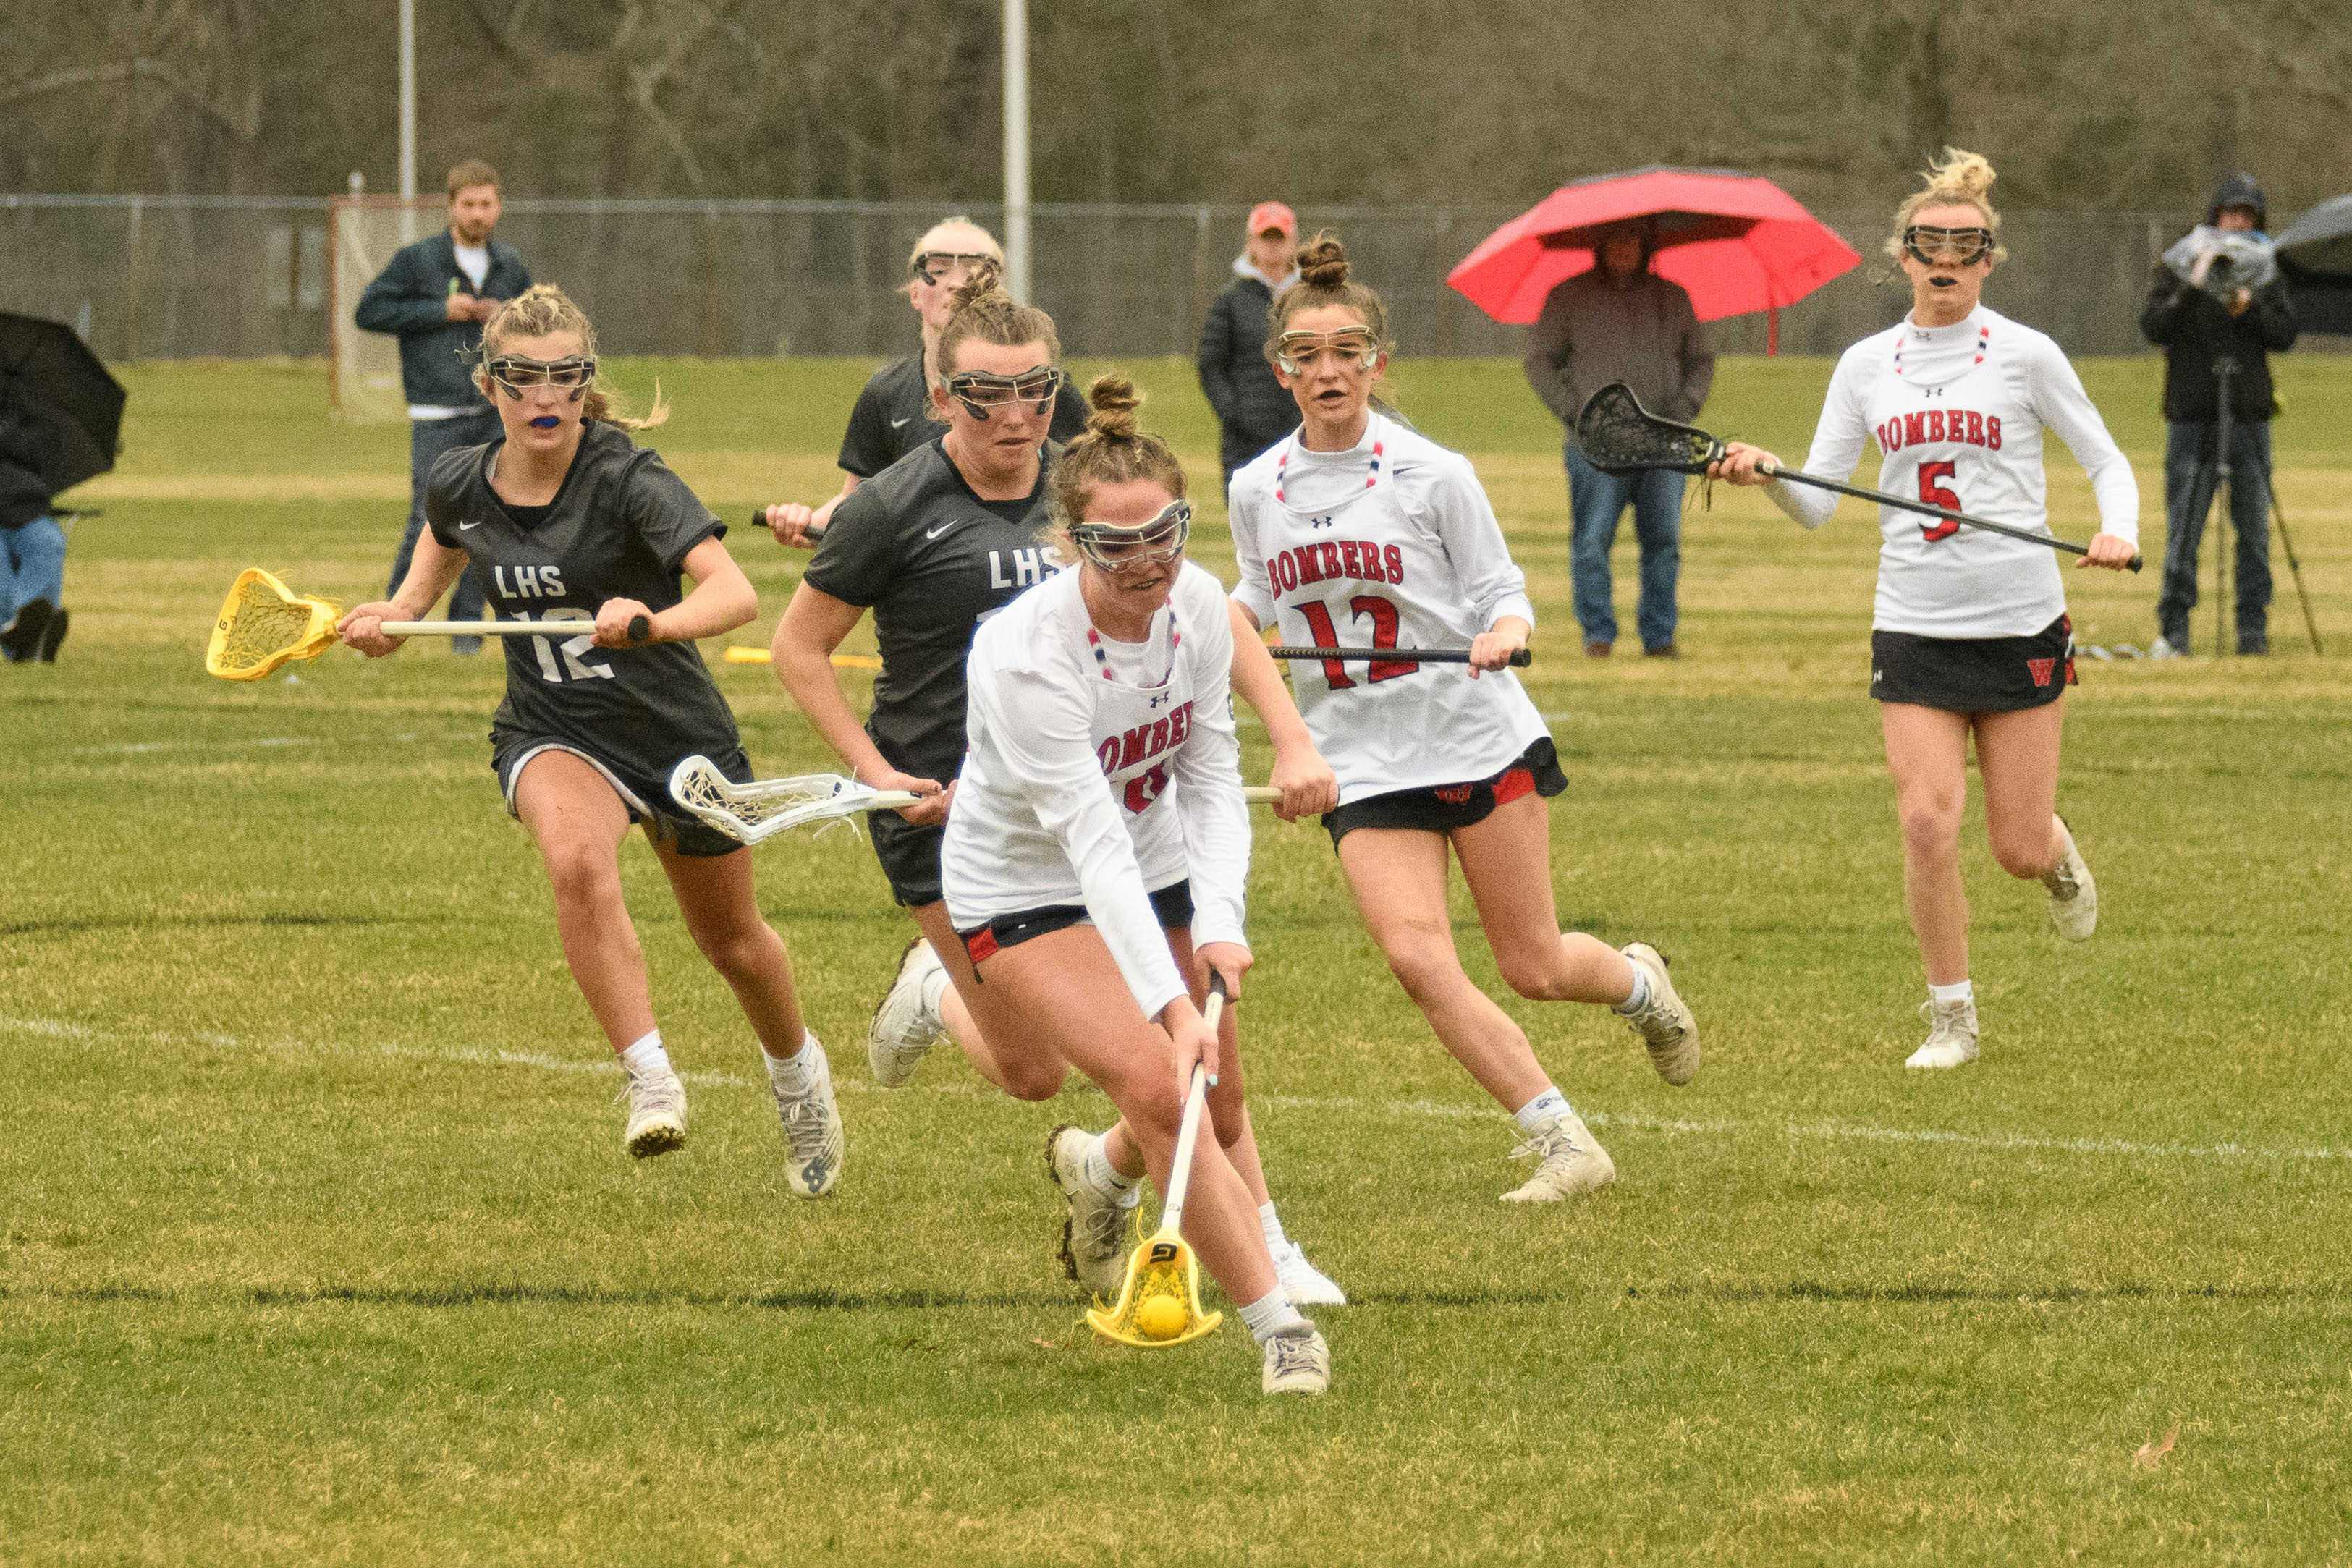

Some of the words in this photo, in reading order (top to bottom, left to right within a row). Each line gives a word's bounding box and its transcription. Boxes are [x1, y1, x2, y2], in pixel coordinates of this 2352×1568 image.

[1917, 459, 1962, 542] 5
[494, 564, 567, 598] LHS
[1266, 540, 1404, 601] BOMBERS
[509, 607, 616, 683] 12
[1291, 594, 1420, 690] 12
[2026, 657, 2056, 687] W
